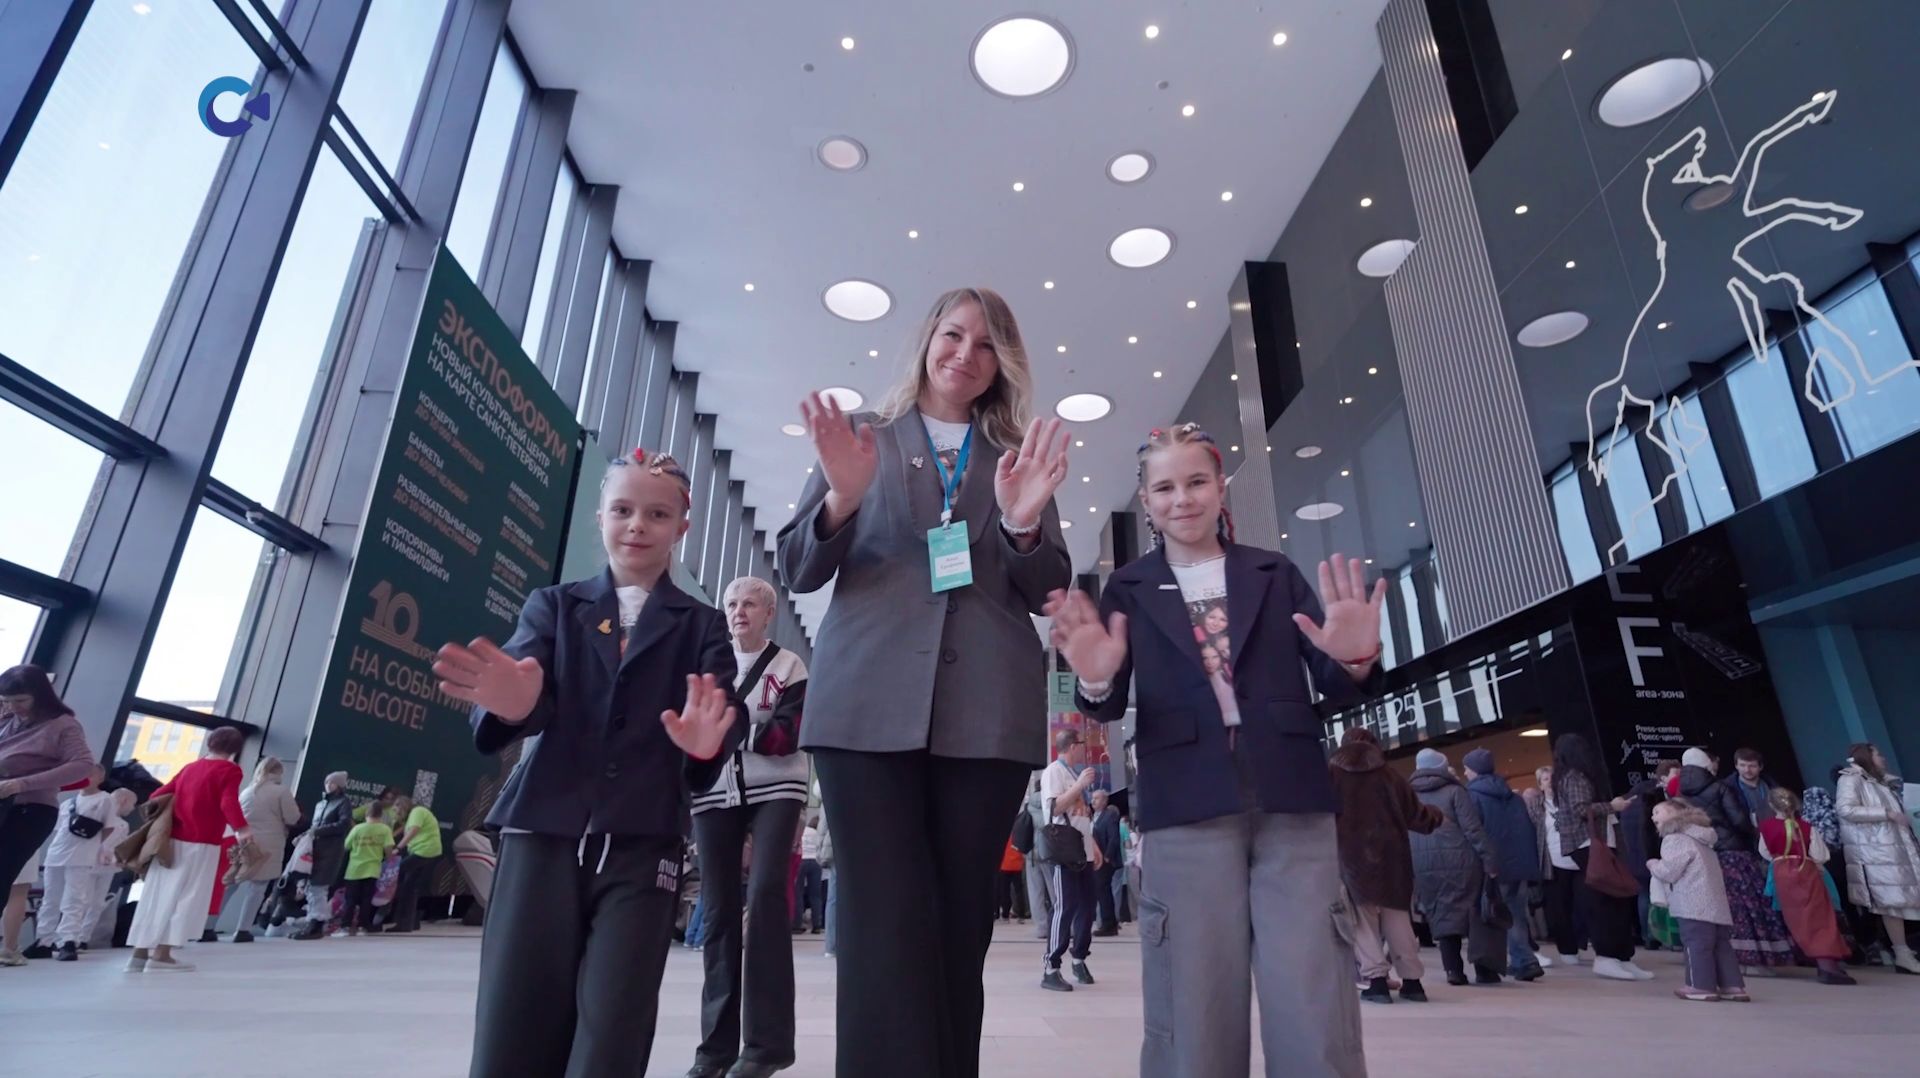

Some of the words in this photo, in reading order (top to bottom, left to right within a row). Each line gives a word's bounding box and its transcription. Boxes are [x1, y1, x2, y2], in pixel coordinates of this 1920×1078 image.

[432, 332, 473, 385] НОВЫЙ
[472, 377, 528, 446] КУЛЬТУРНЫЙ
[526, 438, 551, 469] ЦЕНТР
[439, 298, 567, 467] ЭКСПОФОРУМ
[418, 390, 460, 437] КОНЦЕРТЫ
[427, 350, 444, 379] НА
[445, 368, 477, 413] КАРТЕ
[476, 403, 549, 489] САНКТ-ПЕТЕРБУРГА
[408, 431, 445, 470] БАНКЕТЫ
[397, 473, 467, 535] РАЗВЛЕКАТЕЛЬНЫЕ
[465, 527, 483, 547] ШОУ
[382, 531, 391, 544] И
[391, 534, 451, 583] ТИМБИЛДИНГИ
[385, 516, 444, 566] КОРПОРАТИВЫ
[366, 579, 420, 643] 10
[350, 644, 380, 682] НА
[1616, 617, 1664, 686] F
[341, 679, 428, 731] ВЫСОТЕ!
[1058, 674, 1071, 694] E
